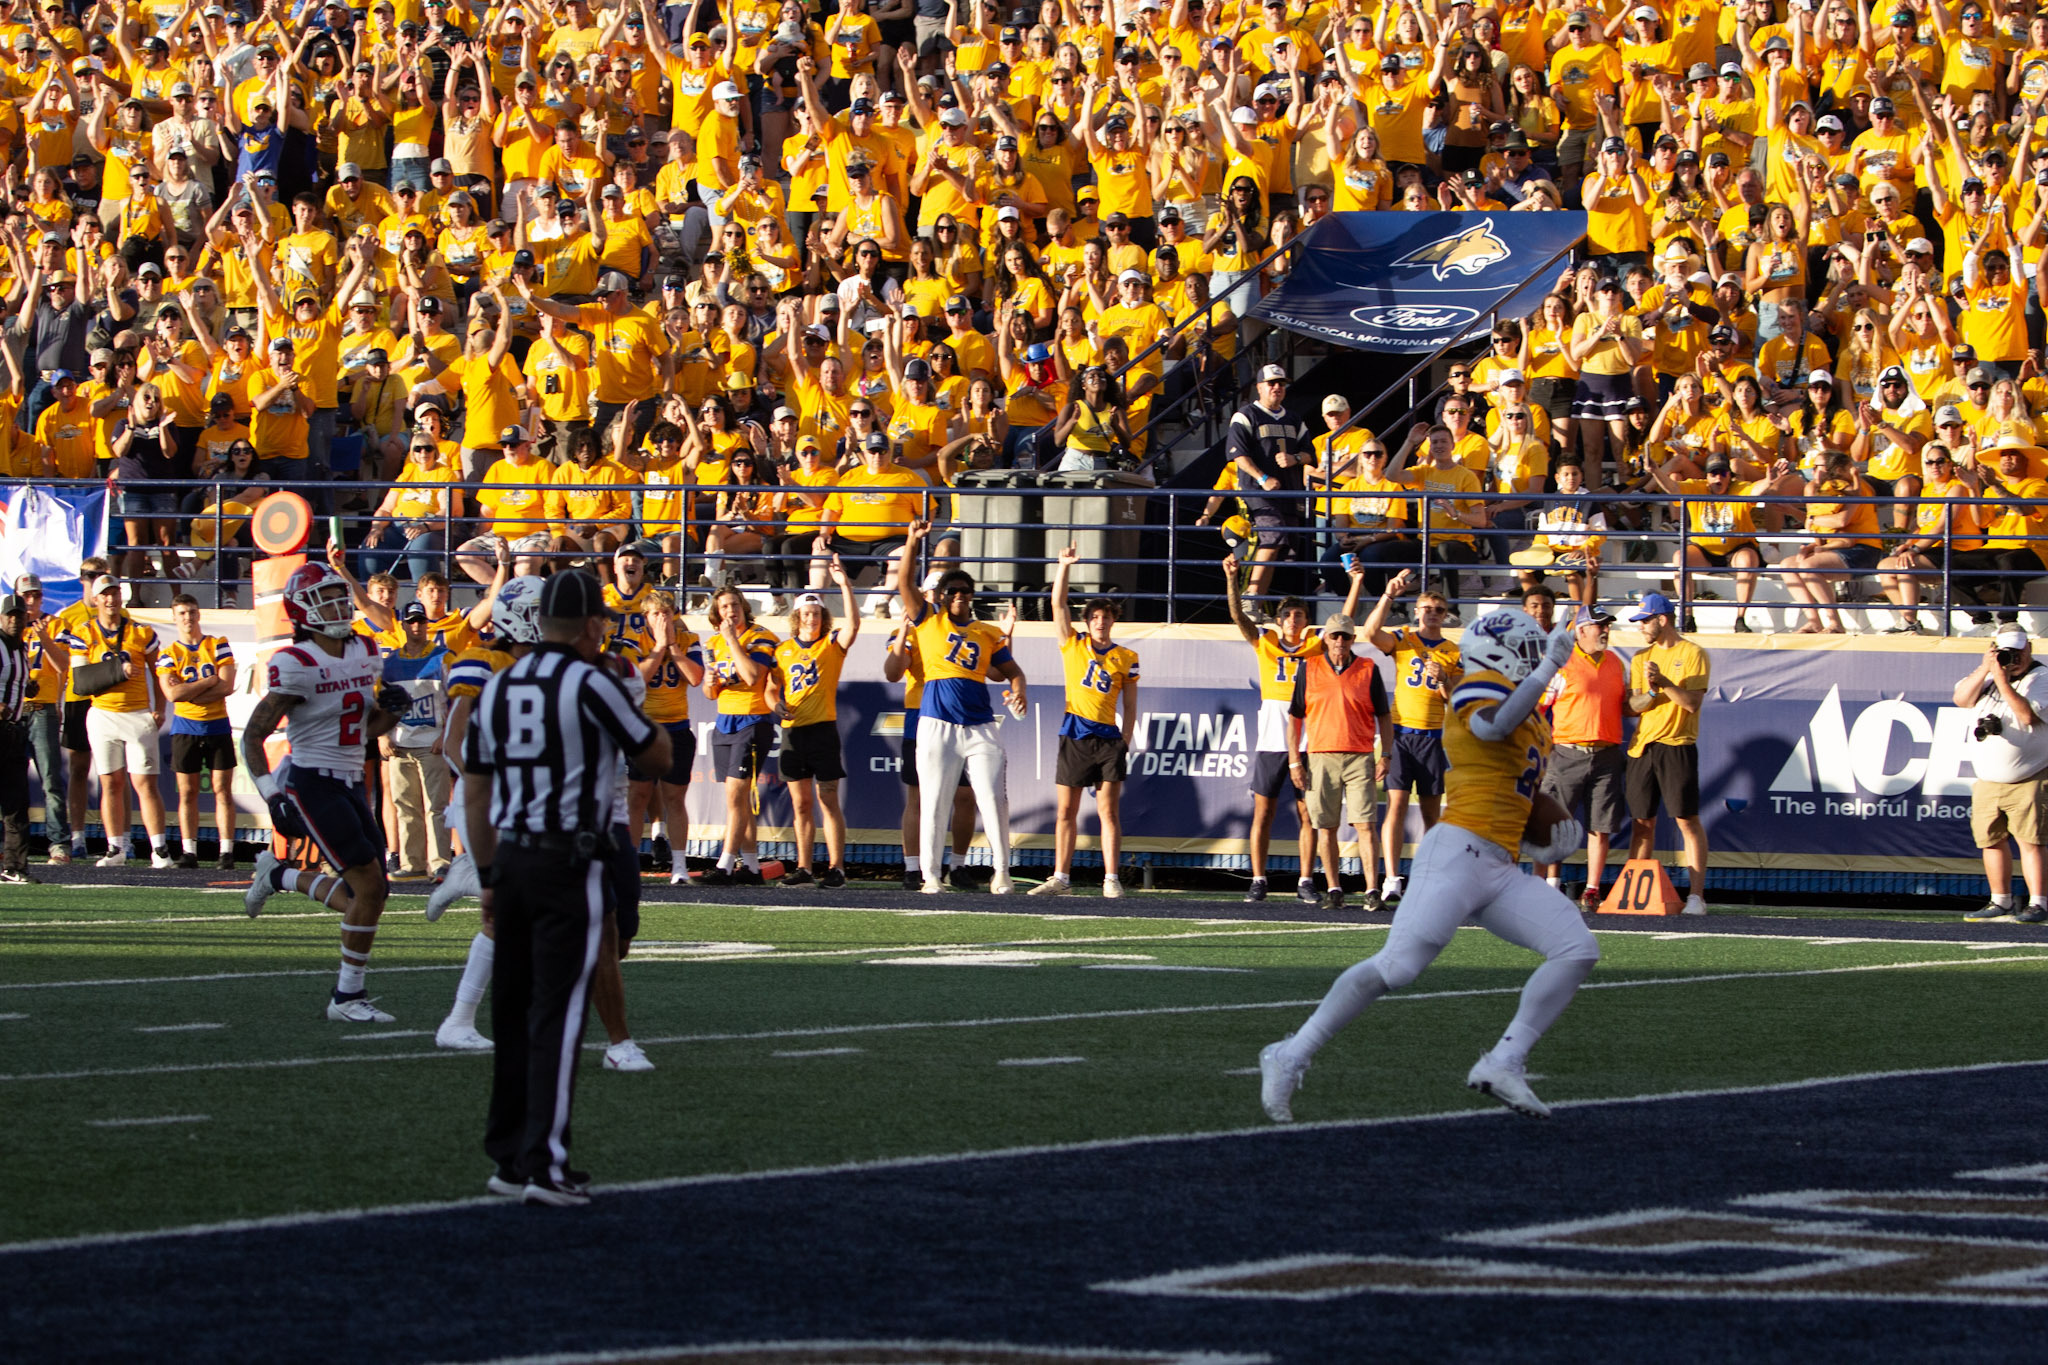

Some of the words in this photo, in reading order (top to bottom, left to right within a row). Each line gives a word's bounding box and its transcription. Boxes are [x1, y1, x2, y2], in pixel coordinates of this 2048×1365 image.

[1269, 311, 1307, 328] YOUR
[1310, 324, 1355, 340] LOCAL
[1357, 334, 1428, 346] MONTANA
[1372, 307, 1458, 328] Ford
[945, 633, 981, 671] 73
[269, 665, 282, 687] 2
[315, 678, 350, 694] UTAH
[340, 690, 365, 746] 2
[505, 685, 546, 759] B
[1115, 711, 1248, 752] NTANA
[1767, 683, 1978, 797] ACE
[1142, 753, 1248, 778] DEALERS
[1770, 796, 1816, 816] The
[1825, 797, 1907, 821] helpful
[1917, 801, 1973, 822] place
[1617, 868, 1654, 911] 10
